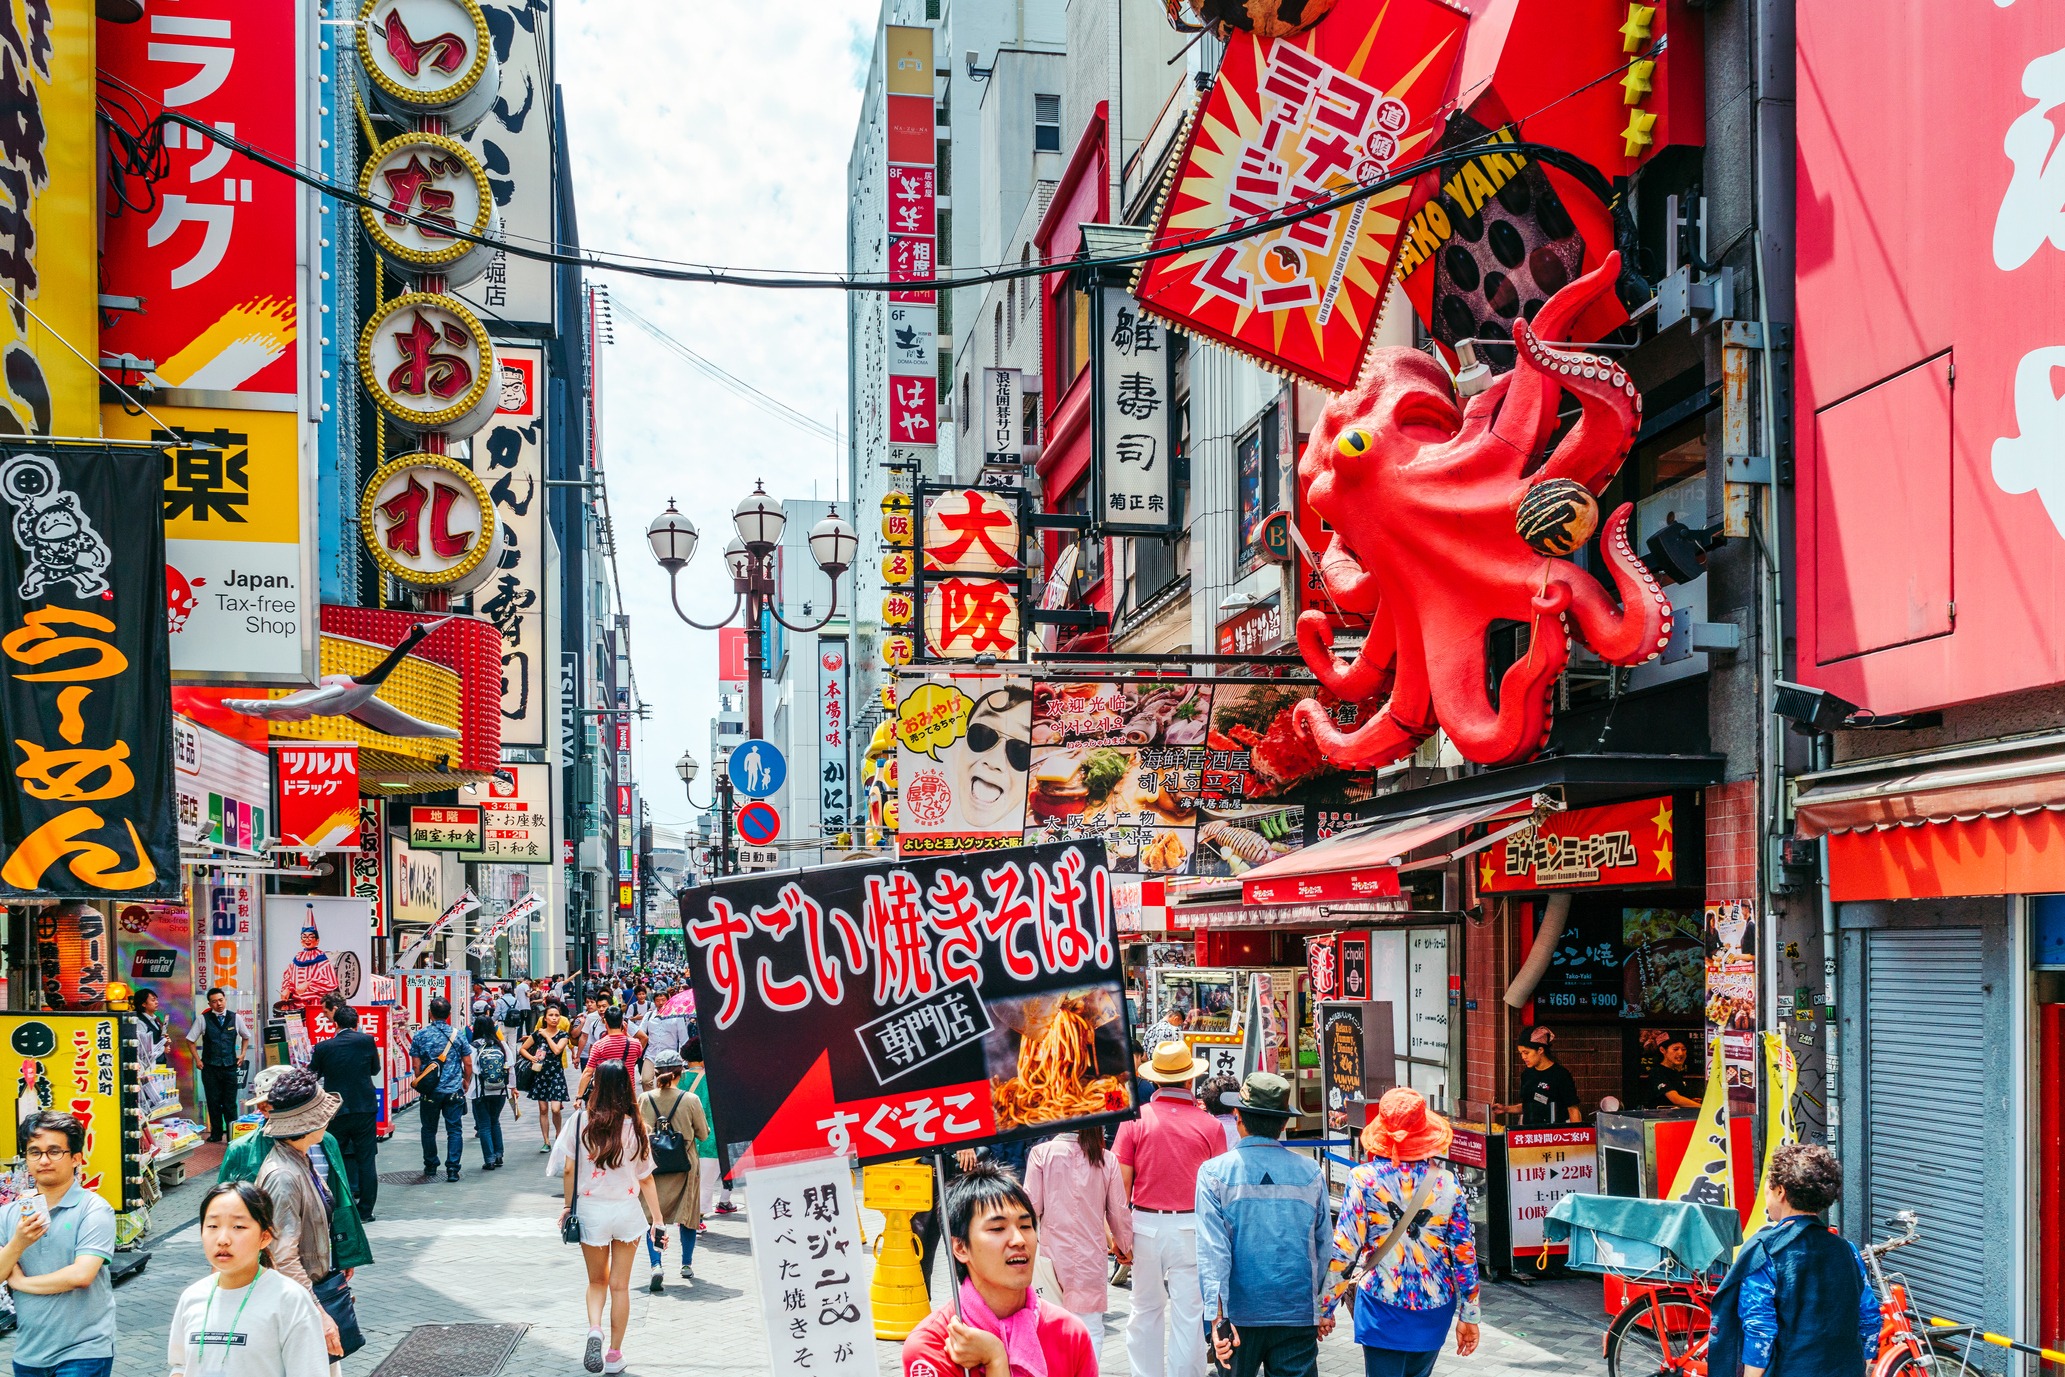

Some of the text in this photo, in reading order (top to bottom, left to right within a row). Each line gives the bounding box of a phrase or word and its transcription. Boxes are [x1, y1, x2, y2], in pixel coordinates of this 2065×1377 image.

[148, 16, 253, 289] ラッグ
[1359, 103, 1406, 188] 道頓堀
[889, 168, 902, 178] 8F
[1394, 124, 1528, 283] AKO YAKI
[1347, 195, 1368, 240] otonbori
[484, 217, 507, 307] 堀店
[912, 242, 930, 277] 相席
[891, 310, 905, 321] 6F
[1110, 305, 1163, 469] 雛寿司
[896, 380, 930, 440] はや
[995, 371, 1012, 452] 浪花囲碁サロン
[891, 449, 904, 459] 4F
[151, 427, 249, 523] 薬
[1109, 492, 1165, 513] 菊正宗
[1269, 525, 1286, 547] B
[223, 569, 296, 591] Japan.
[936, 490, 1018, 654] 大阪
[215, 593, 296, 614] Tax-free
[246, 615, 296, 637] Shop
[561, 662, 574, 769] TSUTAYA
[823, 679, 842, 748] 本場の味
[902, 694, 963, 734] おみやげ
[1046, 694, 1126, 716] 欢迎光临
[1050, 716, 1126, 737] 어서오세요
[2, 604, 158, 891] らーめん
[283, 752, 356, 775] ツルハ
[284, 779, 343, 796] ドラッグ
[1138, 773, 1246, 794] 해선호프집
[822, 760, 845, 838] かに道
[430, 810, 459, 823] 地階
[1043, 811, 1156, 831] 大阪名产物
[740, 851, 777, 863] 自動車
[1505, 831, 1637, 874] コナモンミュージアム
[161, 906, 189, 917] Japan.
[237, 888, 249, 933] 免税店
[168, 924, 189, 933] Shop
[688, 846, 1115, 1030] すごい焼きそば!
[197, 918, 207, 990] TAX FREE SHOP
[1414, 938, 1422, 949] 4F
[79, 914, 105, 1007] ラーメン
[135, 956, 175, 968] UnionPay
[1414, 963, 1422, 973] 3F
[407, 977, 445, 988] 热烈欢迎
[1415, 988, 1422, 998] 2F
[1550, 993, 1618, 1006] ¥650 ¥900
[314, 1013, 380, 1034] 免店
[1415, 1013, 1423, 1023] 1F
[875, 996, 974, 1067] 専門店
[72, 1031, 91, 1092] ニンニク
[97, 1021, 114, 1096] 元祖空心町
[816, 1093, 982, 1156] すぐそこ
[1513, 1131, 1590, 1145] 営業時間のご案内
[1542, 1151, 1565, 1162] 平日
[1516, 1165, 1593, 1181] 11時 22時
[1517, 1205, 1548, 1221] 10時
